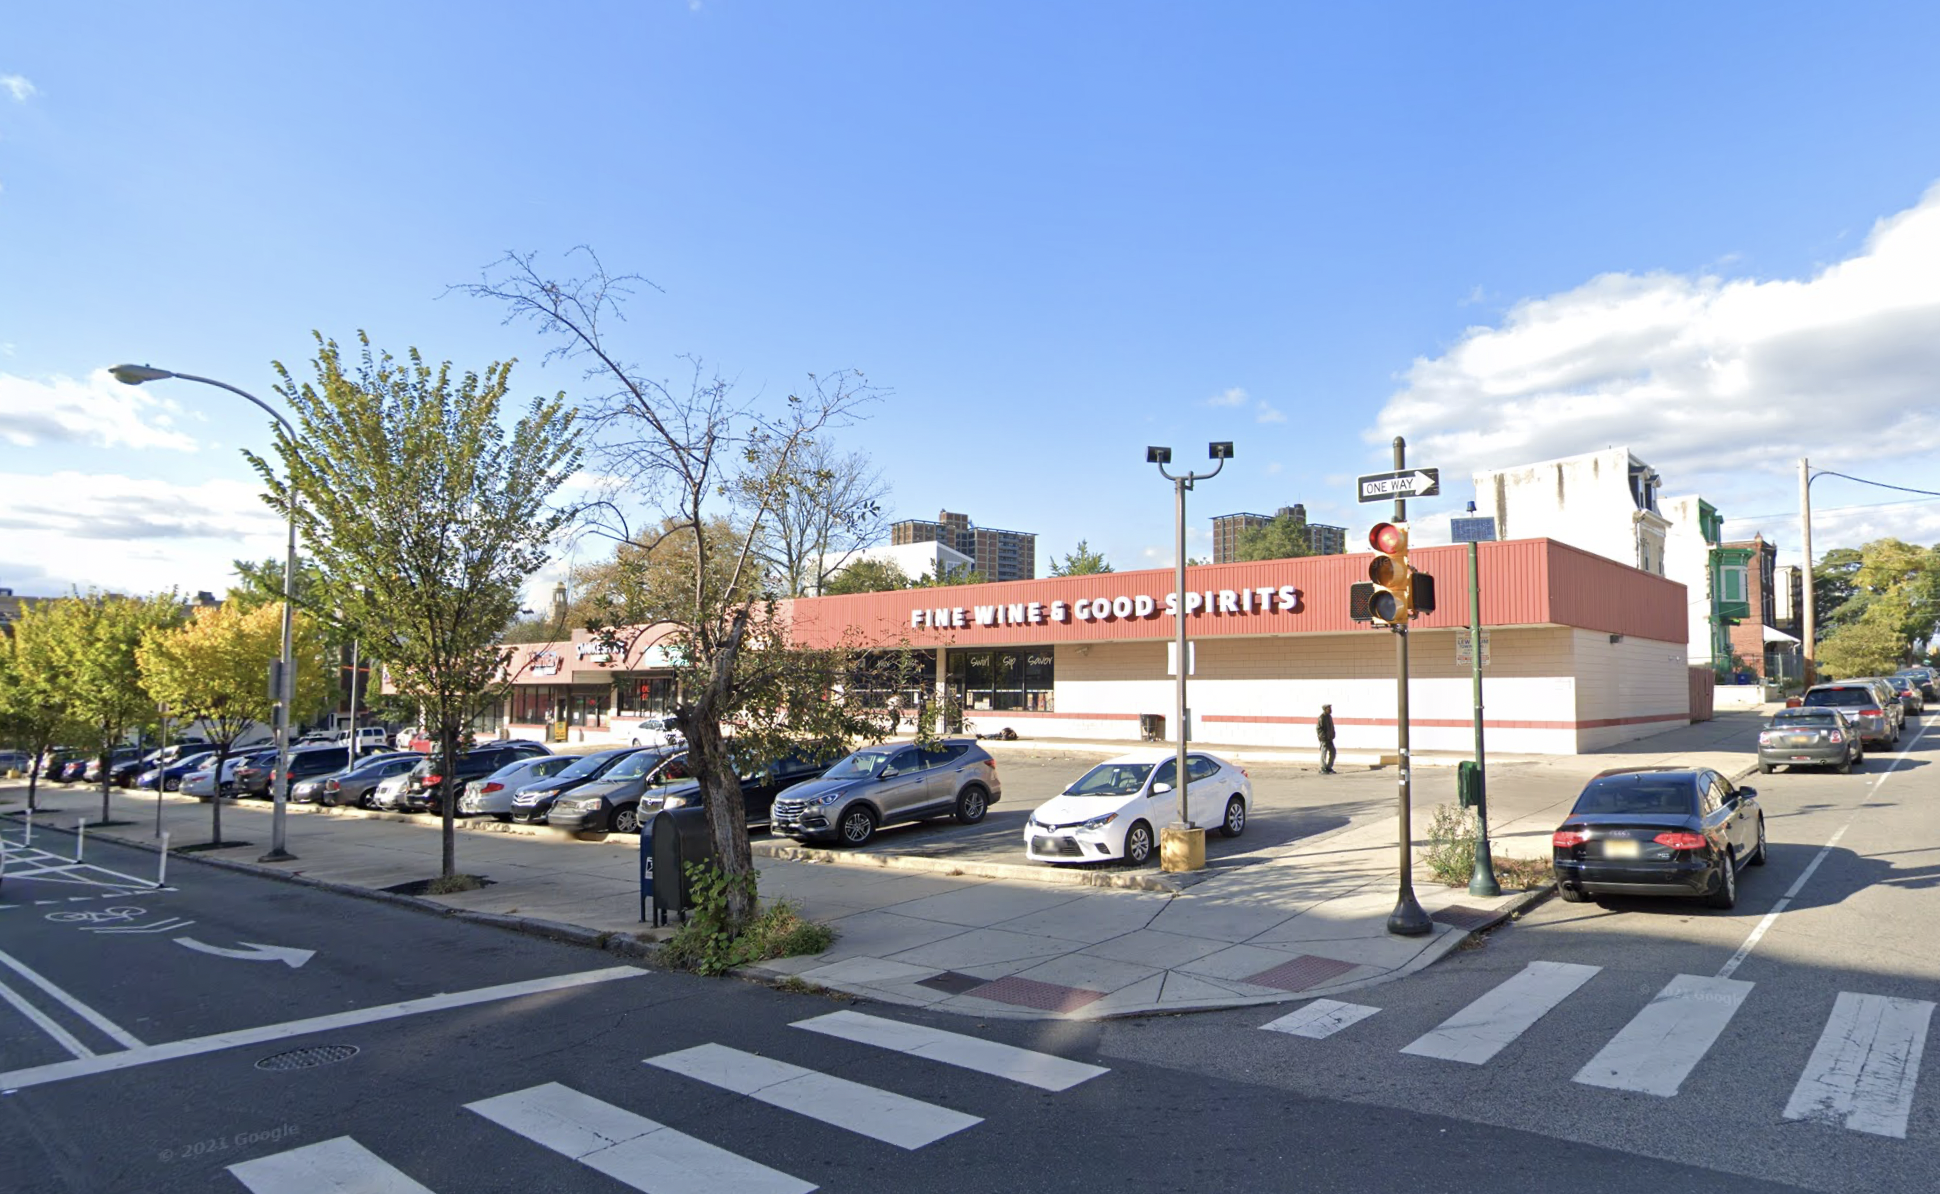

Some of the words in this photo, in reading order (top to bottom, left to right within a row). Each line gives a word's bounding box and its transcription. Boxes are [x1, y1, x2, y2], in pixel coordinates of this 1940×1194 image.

[1366, 482, 1388, 495] ONE
[1391, 478, 1414, 491] WAY
[911, 607, 966, 628] FINE
[973, 601, 1043, 626] WINE
[1051, 600, 1066, 621] &
[1074, 594, 1156, 620] GOOD
[1165, 584, 1298, 616] SPIRITS
[970, 655, 990, 667] Swirl
[1002, 655, 1017, 670] Sip
[1027, 654, 1054, 667] Savor
